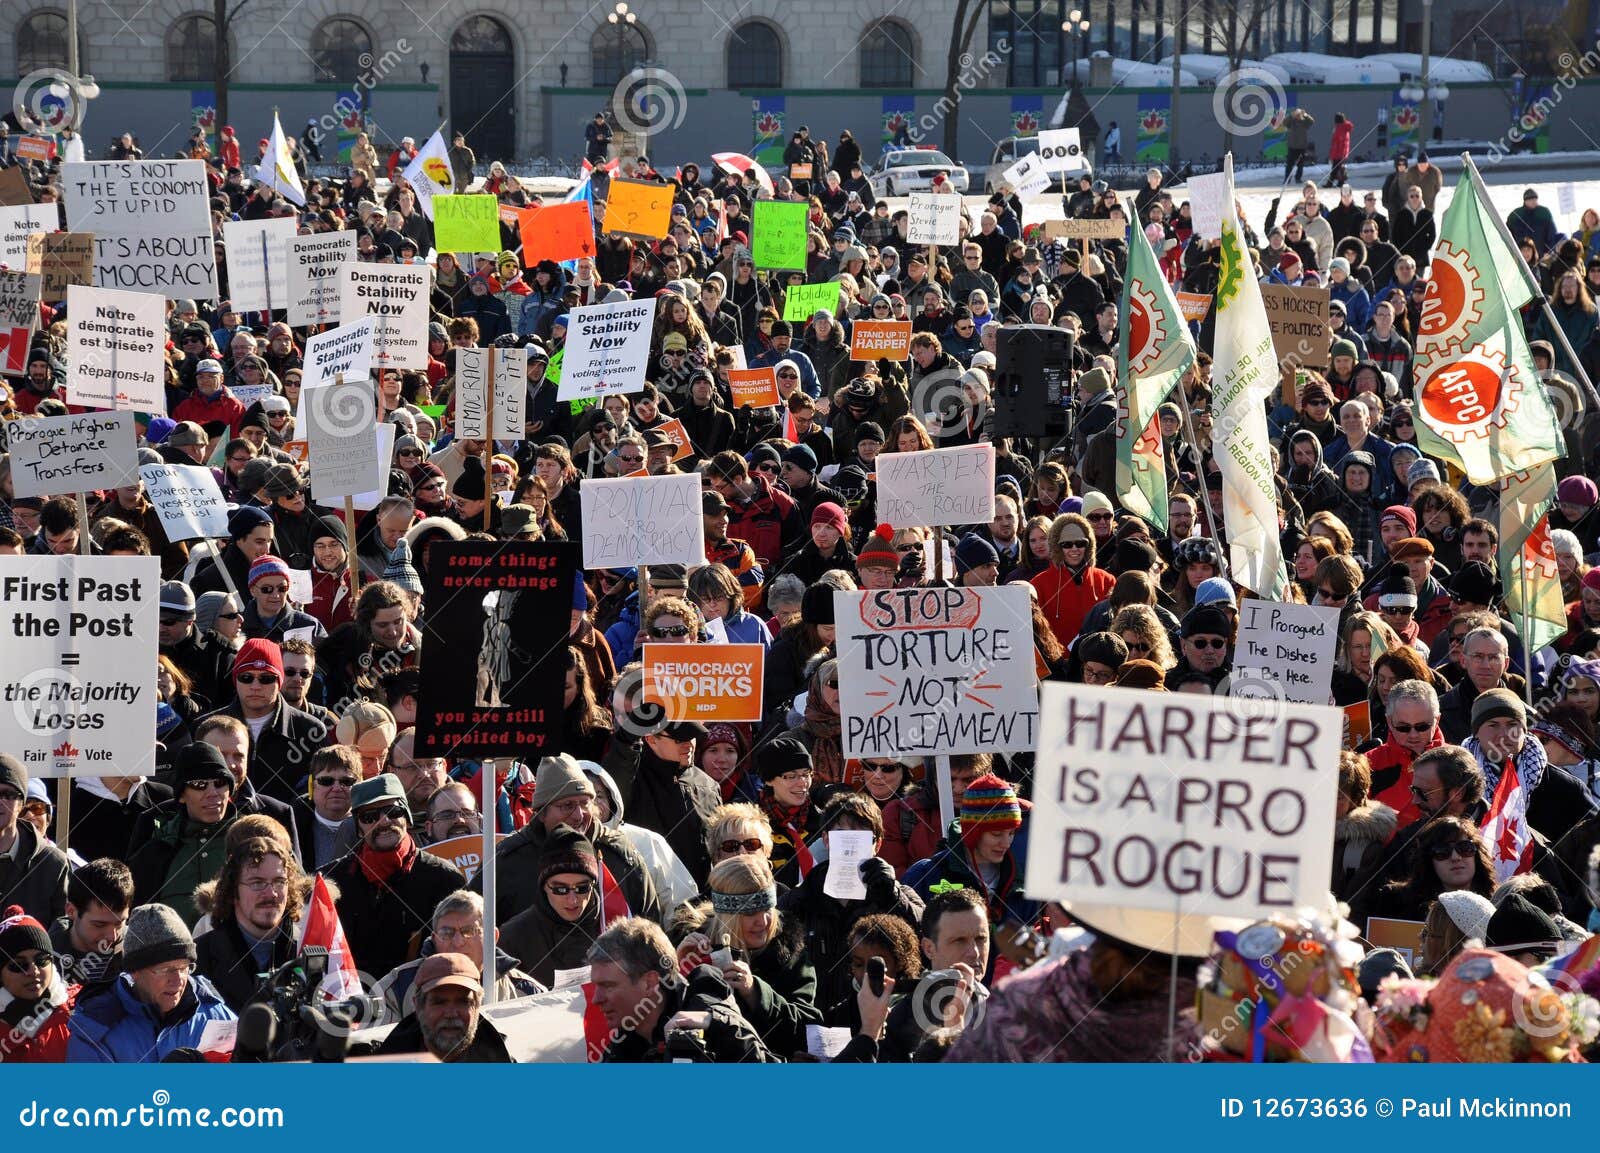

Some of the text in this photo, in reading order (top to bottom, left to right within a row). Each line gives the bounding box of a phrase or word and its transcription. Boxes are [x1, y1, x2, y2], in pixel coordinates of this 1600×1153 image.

[92, 163, 178, 178] IT'S NOT
[76, 182, 206, 197] THE ECONOMY
[95, 199, 176, 215] STUPID
[910, 196, 954, 213] Prorogue
[14, 221, 41, 230] Notre
[910, 212, 937, 225] Stevie
[6, 244, 20, 254] est
[93, 236, 134, 258] T'S
[136, 236, 211, 258] ABOUT
[294, 238, 351, 254] Democratic
[299, 251, 347, 266] Stability
[308, 266, 338, 279] Now
[351, 271, 423, 285] Democratic
[309, 286, 336, 297] Fix the
[357, 286, 417, 302] Stability
[790, 286, 832, 302] Holiday
[297, 296, 321, 306] voting
[366, 301, 405, 316] Now
[1283, 297, 1322, 316] HOCKEY
[95, 306, 136, 321] Notre
[577, 308, 648, 324] Democratic
[78, 320, 154, 338] démocratie
[385, 326, 400, 335] the
[582, 321, 641, 337] Stability
[1282, 321, 1323, 337] POLITICS
[79, 337, 154, 354] est brisée?
[313, 326, 370, 354] Democratic
[384, 337, 418, 347] system
[589, 335, 628, 350] Now
[855, 338, 907, 349] HARPER
[315, 342, 364, 366] Stability
[392, 354, 407, 362] Vote
[321, 360, 352, 380] Now
[588, 357, 621, 368] Fix the
[78, 364, 155, 383] Réparons-la
[571, 365, 636, 379] voting system
[463, 348, 481, 437] DEMOCRACY
[580, 381, 624, 393] Fair Vote
[1438, 369, 1486, 422] AFPC
[506, 394, 521, 434] KEEP
[8, 419, 121, 445] Prorogue Afghan
[38, 440, 107, 459] Detainee
[25, 458, 105, 481] Transfers
[889, 452, 989, 480] HARPER
[1228, 443, 1261, 481] REGION
[150, 487, 207, 498] sweater
[917, 482, 945, 496] THE
[158, 499, 191, 510] vests
[591, 482, 702, 522] PONTIAC
[933, 496, 990, 519] ROGUE
[626, 519, 656, 533] PRO
[589, 527, 698, 564] DEMOCRACY
[448, 554, 558, 570] some things
[3, 577, 141, 601] First Past
[443, 575, 558, 590] never change
[874, 588, 965, 627] STOP
[12, 613, 134, 637] the Post
[1245, 606, 1325, 640] I Prorogued
[851, 628, 1011, 670] TORTURE
[1247, 641, 1318, 664] The Dishes
[653, 663, 753, 676] DEMOCRACY
[1237, 665, 1314, 685] To Be Here.
[5, 683, 141, 704] the Majority
[653, 677, 753, 697] WORKS
[898, 675, 969, 707] NOT
[695, 704, 717, 712] NDP
[32, 709, 105, 730] Loses
[435, 709, 546, 726] you are still
[427, 731, 546, 747] a spoiled boy
[848, 711, 1039, 753] PARLIAMENT
[1067, 697, 1321, 770] HARPER
[23, 749, 113, 762] Fair Vote
[1058, 765, 1306, 837] IS A PRO
[1060, 827, 1300, 906] ROGUE
